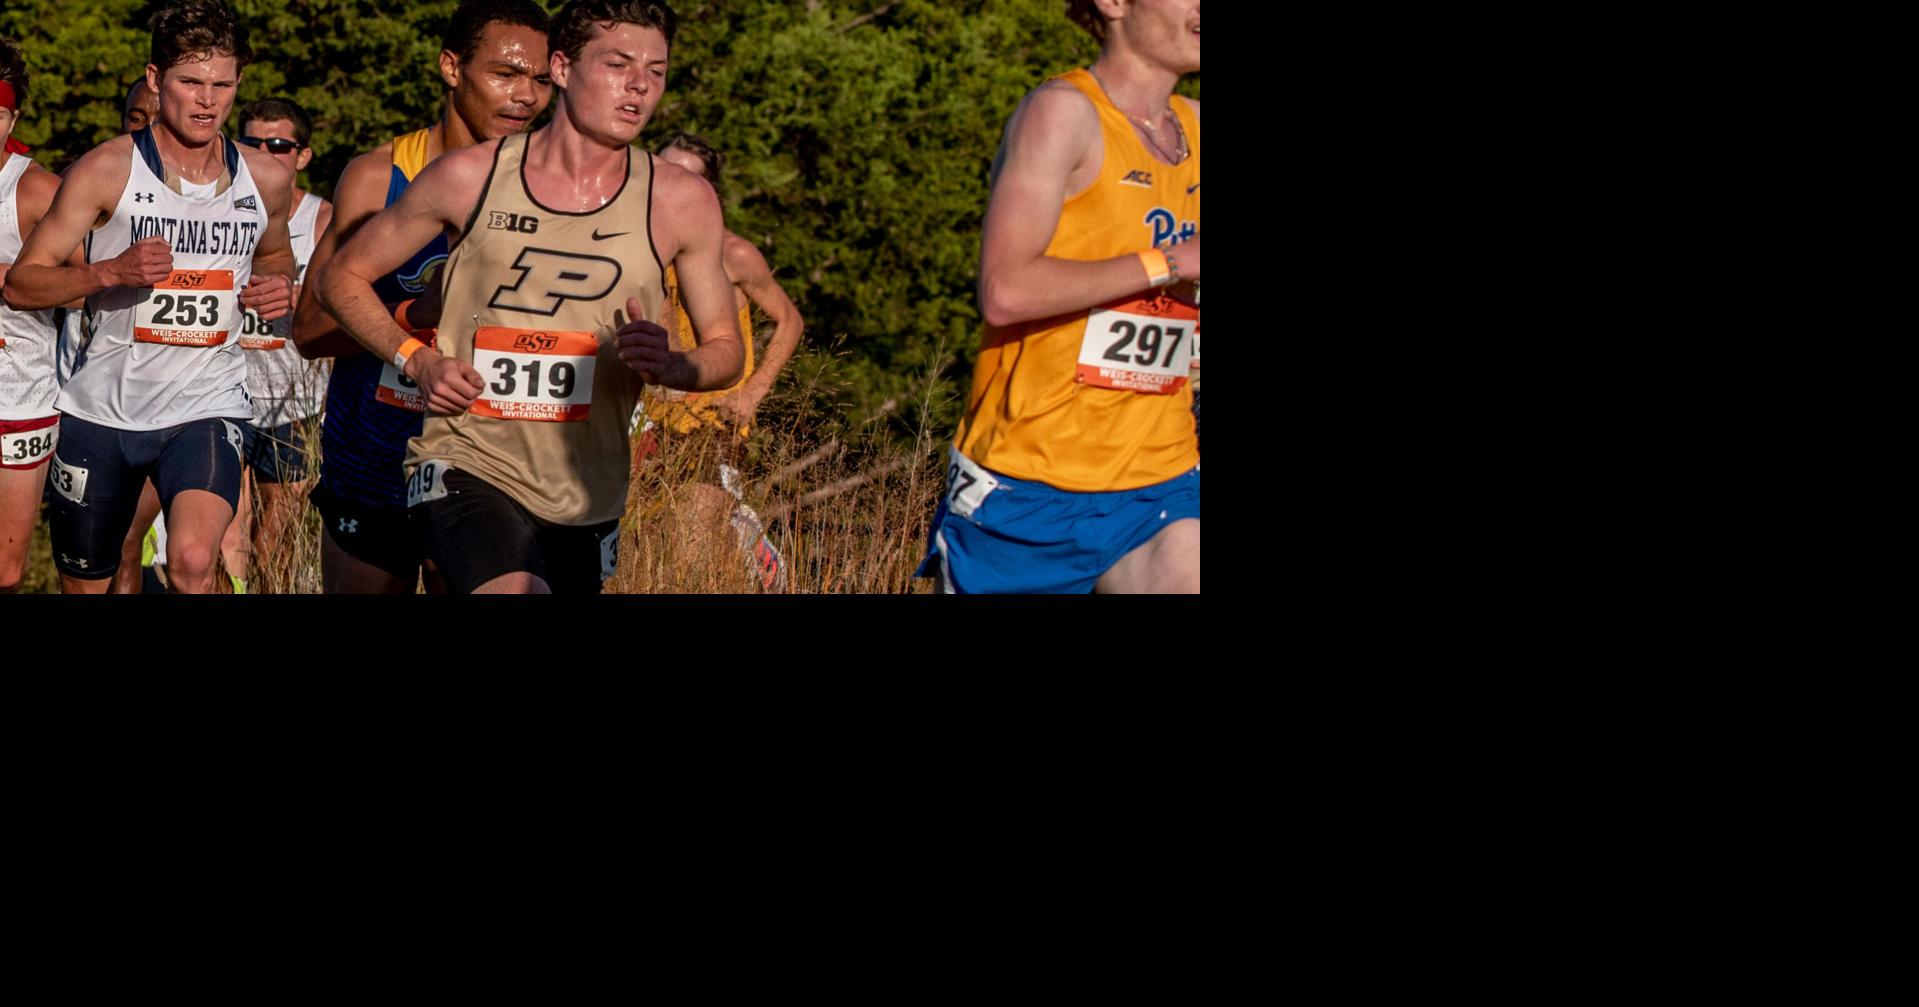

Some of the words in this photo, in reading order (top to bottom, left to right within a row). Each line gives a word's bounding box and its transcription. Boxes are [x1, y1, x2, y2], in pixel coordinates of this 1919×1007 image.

[1122, 169, 1152, 186] ACC
[130, 215, 207, 254] MONTANA
[210, 221, 258, 256] STATE
[171, 271, 206, 289] OSU
[487, 246, 623, 317] P
[151, 294, 219, 327] 253
[151, 329, 218, 339] WEIS-CROCKETT
[162, 336, 208, 344] INVITATIONAL
[513, 332, 559, 352] OSU
[1102, 320, 1185, 368] 297
[490, 357, 576, 399] 319
[490, 400, 572, 413] WEIS-CROCKETT
[502, 409, 558, 419] INVITATIONAL
[13, 432, 52, 460] 384
